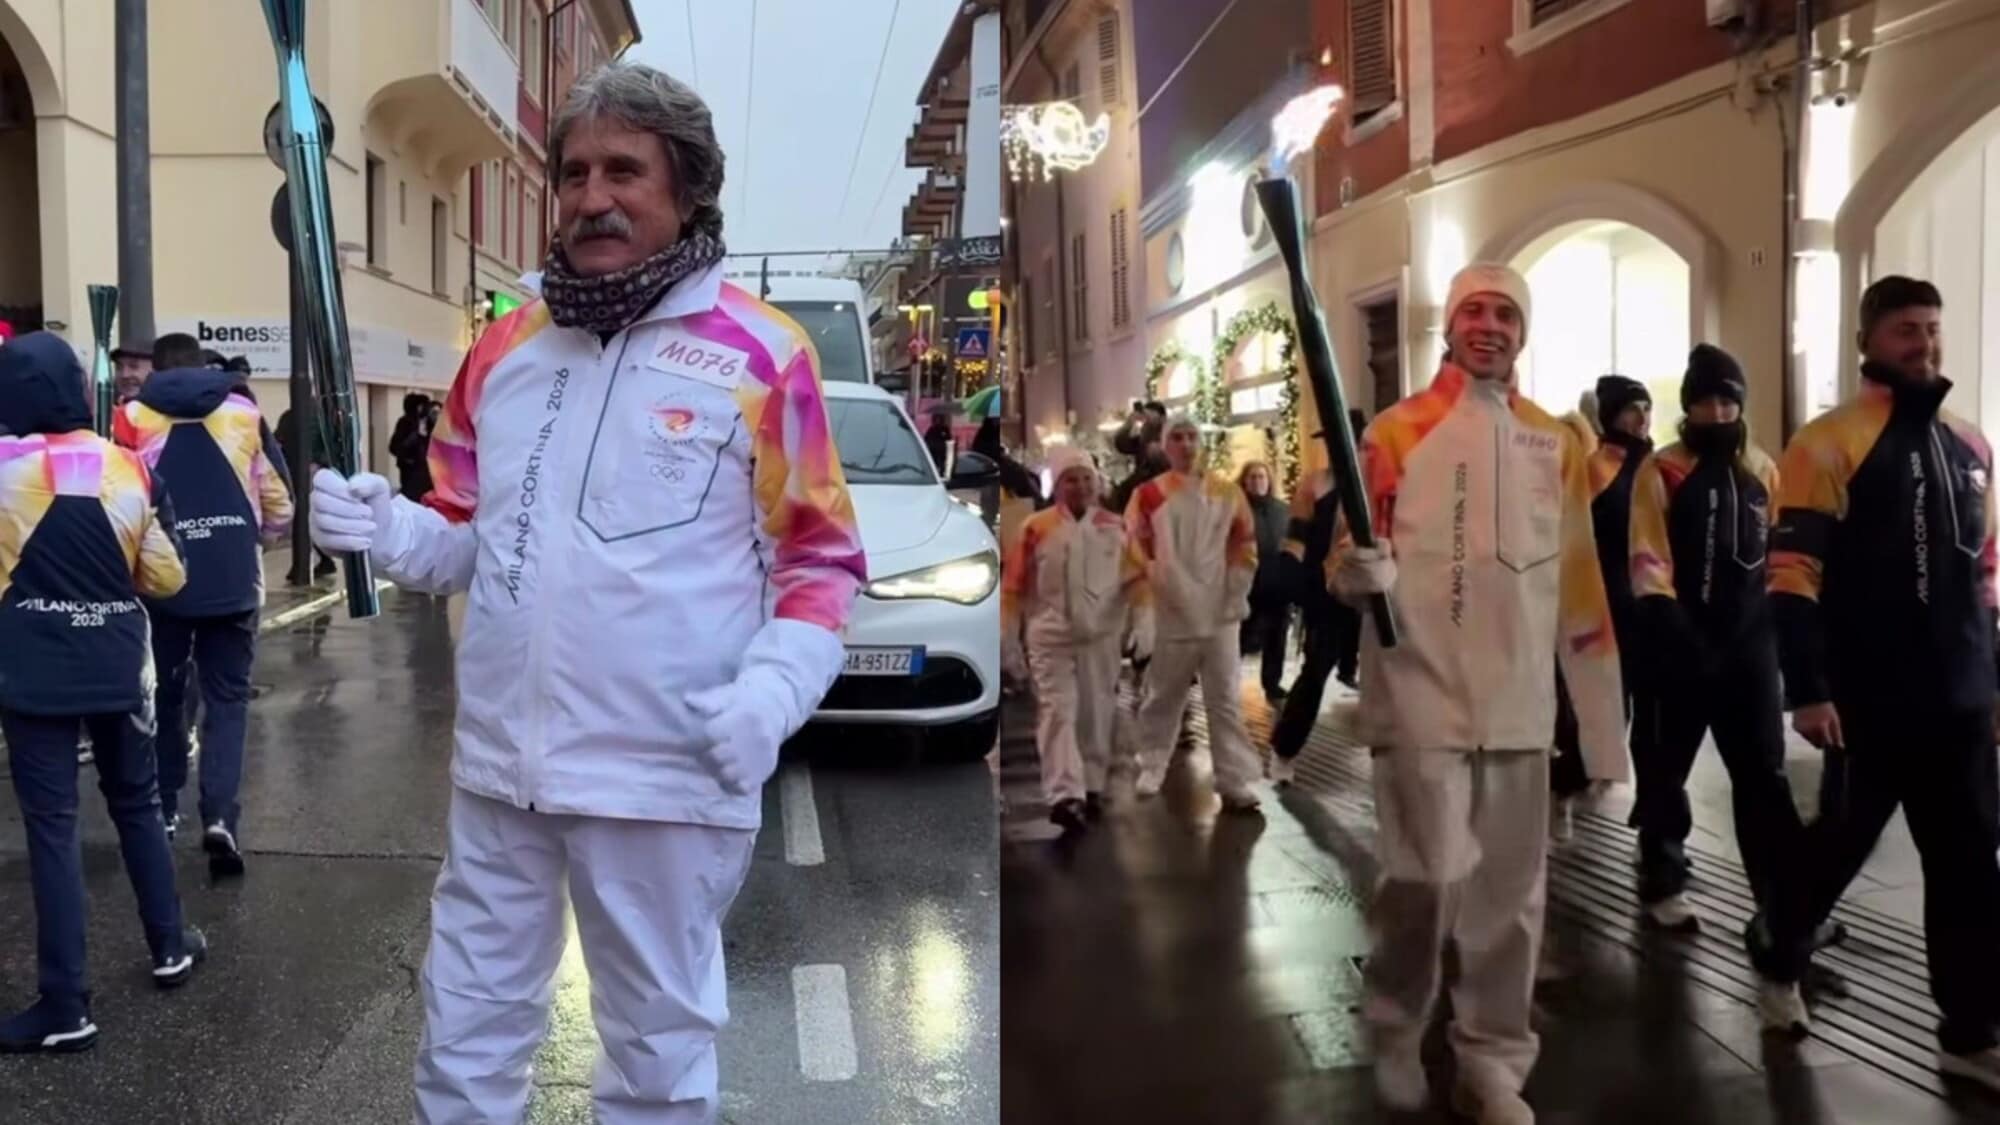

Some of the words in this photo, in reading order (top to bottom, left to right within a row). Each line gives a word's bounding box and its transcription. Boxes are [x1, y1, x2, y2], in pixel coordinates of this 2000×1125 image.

[505, 511, 531, 605] MILANO
[520, 417, 558, 509] CORTINA
[547, 367, 571, 412] 2026
[1913, 481, 1927, 542] CORTINA
[198, 515, 247, 528] CORTINA
[1453, 499, 1466, 562] CORTINA
